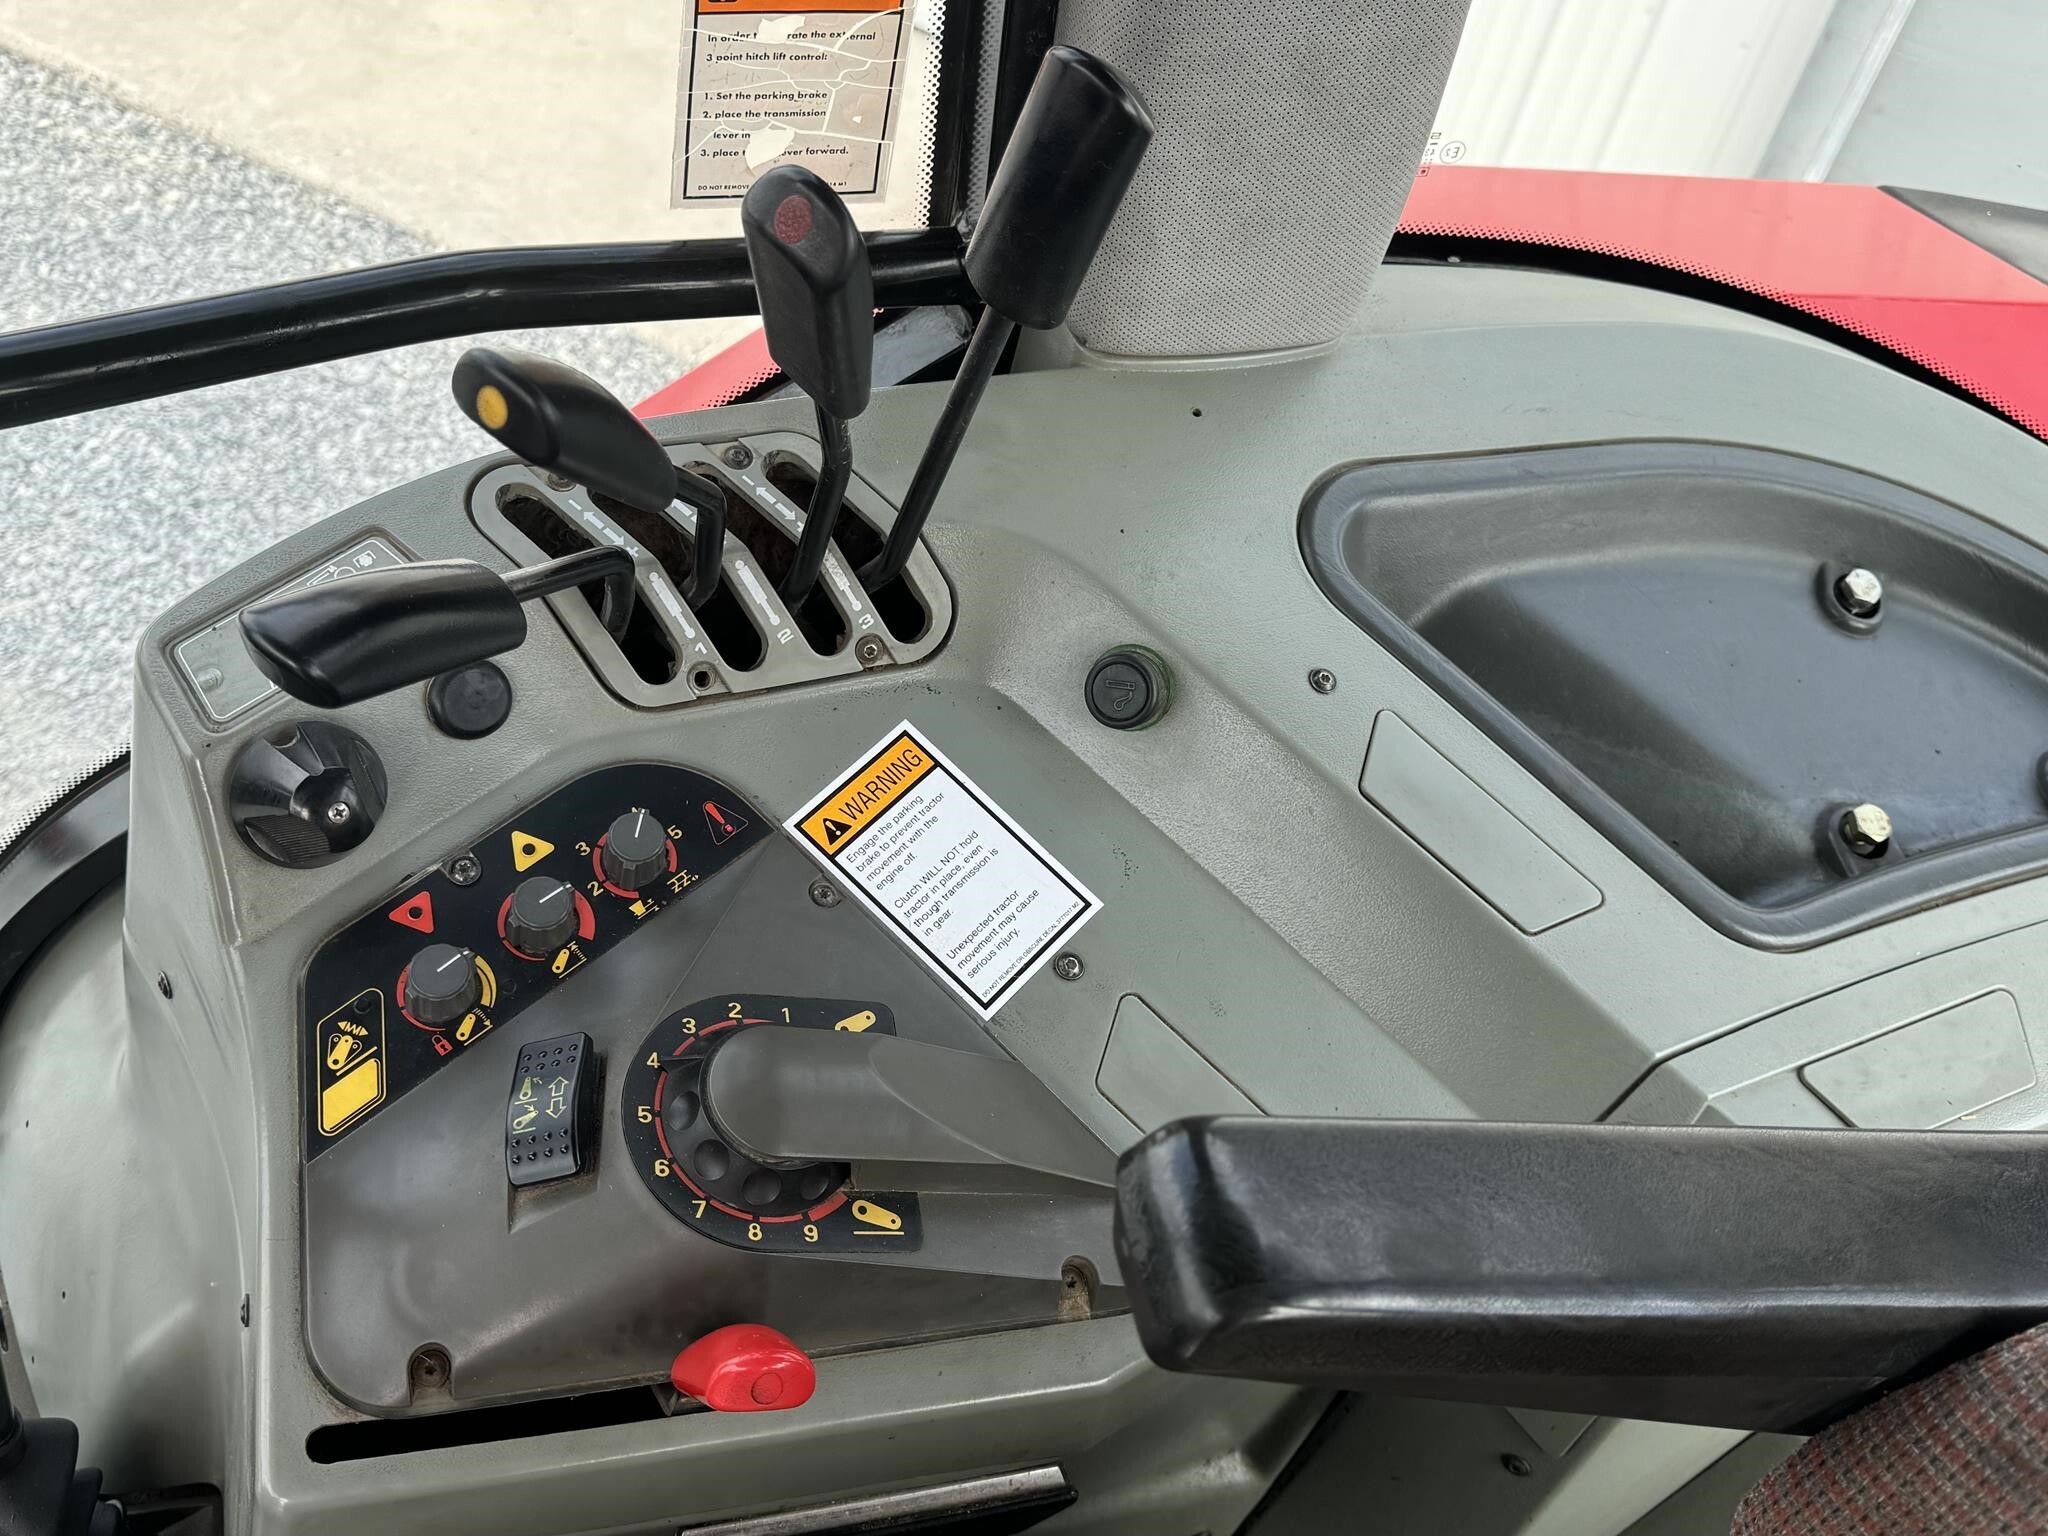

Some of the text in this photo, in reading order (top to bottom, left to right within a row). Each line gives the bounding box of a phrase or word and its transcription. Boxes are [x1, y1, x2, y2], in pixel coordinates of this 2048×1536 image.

[707, 34, 717, 42] In
[811, 30, 826, 39] the
[705, 52, 828, 64] 3 point hitch lift control:
[704, 90, 828, 102] 1. Set the parking brake
[702, 109, 827, 119] 2. place the transmission
[713, 131, 751, 140] lever in
[700, 149, 710, 157] 3.
[712, 148, 740, 158] place
[806, 146, 849, 155] forward.
[858, 613, 875, 630] 3
[776, 628, 794, 645] 2
[838, 748, 924, 821] WARNING
[667, 824, 683, 839] 5
[846, 795, 924, 863] Engage the parking
[855, 792, 944, 872] brake to prevent tractor
[575, 841, 591, 856] 3
[866, 816, 938, 881] movement with the
[876, 852, 917, 890] engine off.
[894, 830, 978, 908] Clutch WILL NOT hold
[587, 881, 604, 896] 2
[903, 845, 983, 918] tractor in place, even
[913, 848, 998, 927] though transmission is
[924, 909, 953, 936] in gear.
[946, 890, 1019, 959] Unexpected tractor
[957, 889, 1039, 969] movement may cause
[967, 928, 1020, 978] serious injury.
[981, 989, 990, 998] DO
[989, 979, 999, 990] NOT
[998, 962, 1017, 981] REMOVE
[1015, 955, 1024, 964] OR
[1022, 936, 1044, 957] OBSCURE
[1042, 923, 1057, 938] DECAL
[1071, 901, 1079, 909] M2
[728, 1002, 742, 1018] 2
[781, 1008, 790, 1023] 1
[681, 1018, 697, 1034] 3
[646, 1052, 660, 1069] 4
[637, 1106, 652, 1123] 5
[654, 1159, 670, 1177] 6
[692, 1200, 707, 1219] 7
[748, 1223, 763, 1241] 8
[803, 1224, 819, 1242] 9
